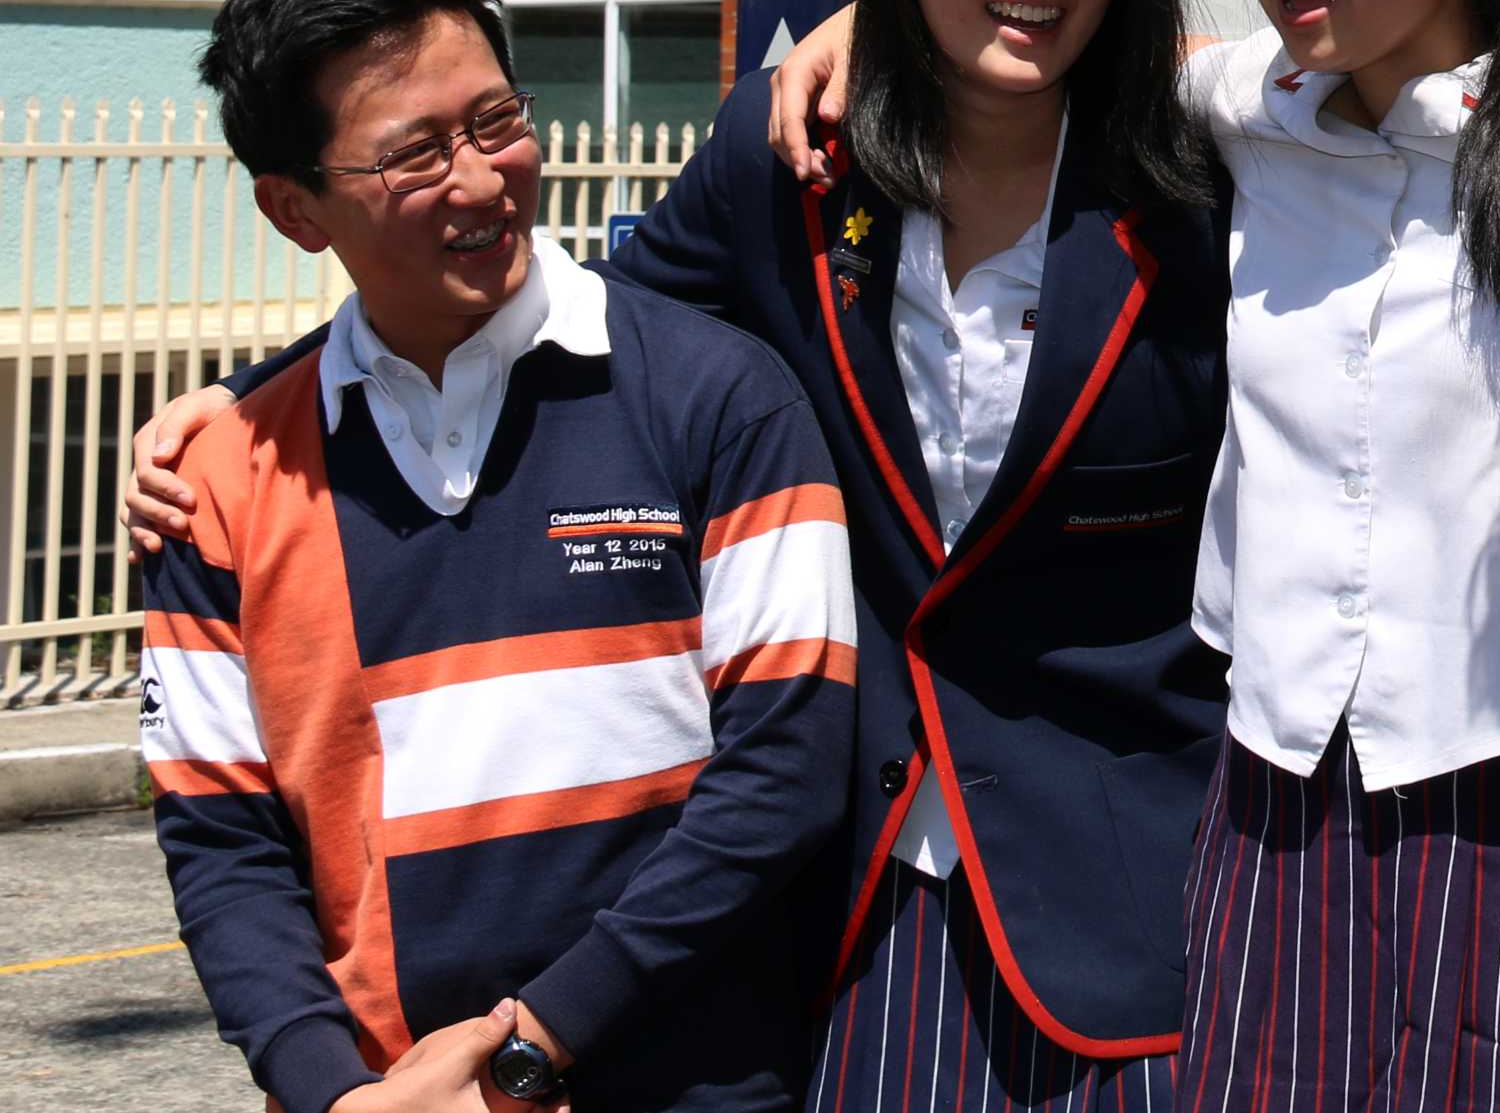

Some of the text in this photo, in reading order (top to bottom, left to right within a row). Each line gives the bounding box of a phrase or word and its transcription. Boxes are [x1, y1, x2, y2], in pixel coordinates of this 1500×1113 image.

[550, 507, 680, 525] Chatswood High School
[562, 539, 666, 557] Year 12 2015
[569, 556, 662, 574] Alan Zheng
